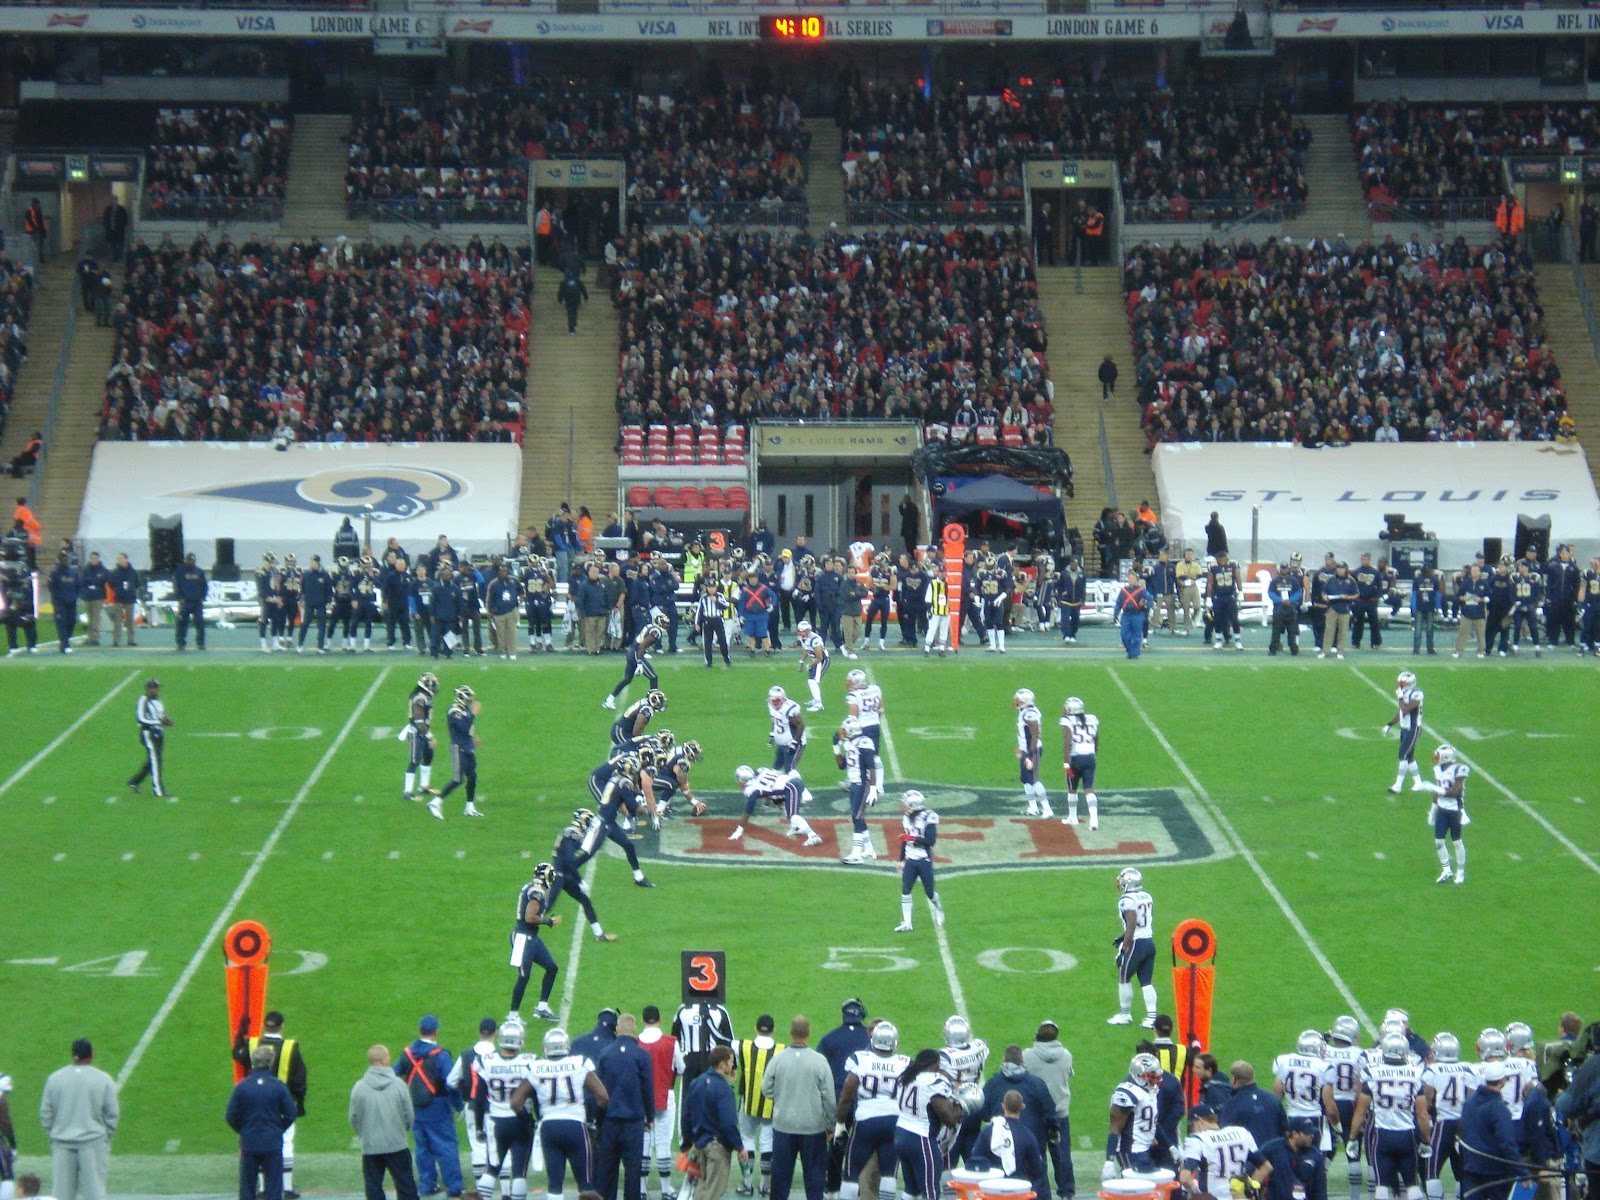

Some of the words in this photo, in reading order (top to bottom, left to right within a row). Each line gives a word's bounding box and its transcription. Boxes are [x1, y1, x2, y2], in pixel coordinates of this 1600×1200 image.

[236, 16, 276, 31] VISA
[310, 16, 363, 33] LONDON
[637, 20, 676, 35] VISA
[708, 19, 733, 36] NFL
[774, 16, 822, 38] 4:10
[847, 20, 892, 36] SERIES
[1047, 19, 1099, 36] LONDON
[1105, 19, 1145, 36] GAME
[1150, 19, 1159, 35] 6
[1484, 16, 1525, 30] VISA
[1556, 14, 1581, 30] NFL
[1205, 489, 1306, 503] ST.
[1334, 489, 1561, 503] LOUIS
[709, 531, 726, 551] 3
[688, 955, 719, 991] 3
[871, 1061, 897, 1073] BRACE
[539, 1076, 578, 1107] 71
[863, 1075, 900, 1101] 97
[1284, 1071, 1318, 1102] 43
